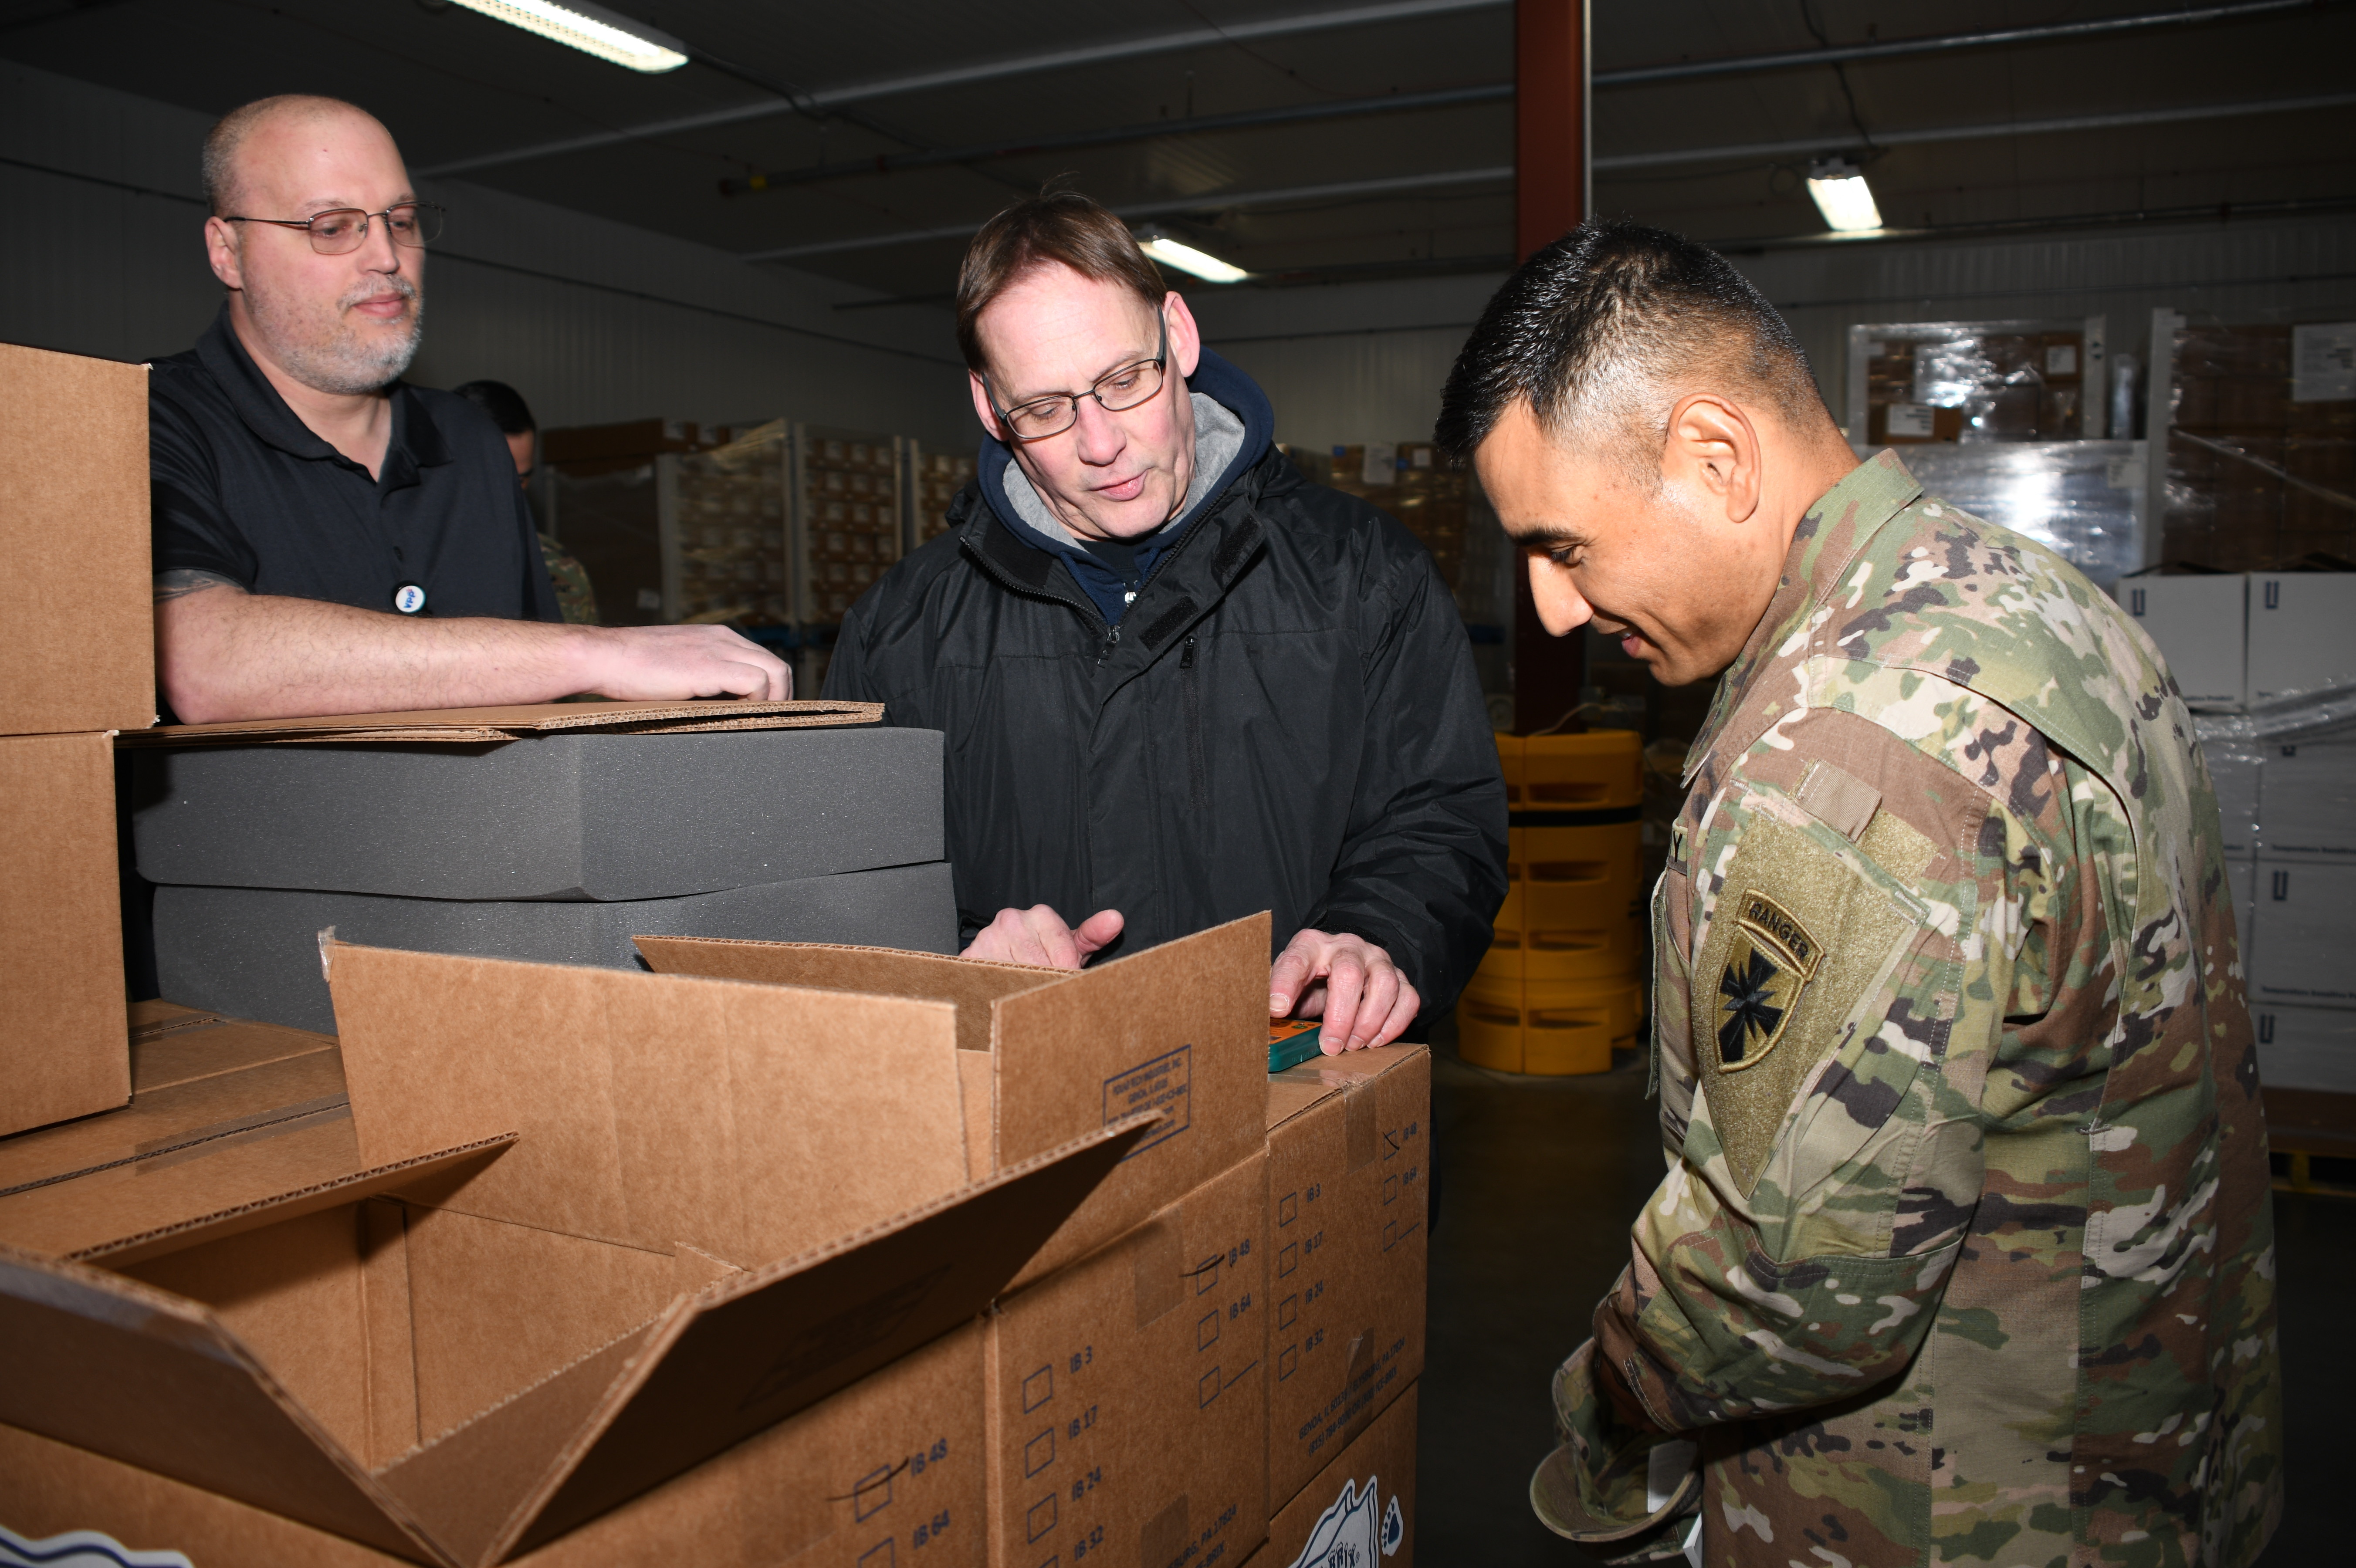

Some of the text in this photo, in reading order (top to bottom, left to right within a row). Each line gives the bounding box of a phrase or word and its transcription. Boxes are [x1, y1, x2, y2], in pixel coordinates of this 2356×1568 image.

[1749, 902, 1808, 960] RANGER
[1403, 1122, 1417, 1141] IB 48
[1403, 1166, 1416, 1186] IB 64
[1307, 1183, 1320, 1203] IB 3
[1229, 1238, 1250, 1266] IB 48
[1305, 1230, 1323, 1254] IB 17
[1306, 1280, 1324, 1304] IB 24
[1229, 1293, 1251, 1321] IB 64
[1306, 1328, 1323, 1353] IB 32
[1070, 1345, 1092, 1374] IB 3
[1300, 1413, 1323, 1440] GENOA,
[1324, 1405, 1329, 1417] IL
[1382, 1351, 1389, 1365] PA
[1068, 1404, 1098, 1440] IB 17
[911, 1438, 948, 1477] IB 48
[1072, 1466, 1101, 1502] IB 24
[913, 1509, 950, 1550] IB 64
[1074, 1525, 1104, 1561] IB 32
[1201, 1527, 1212, 1545] PA
